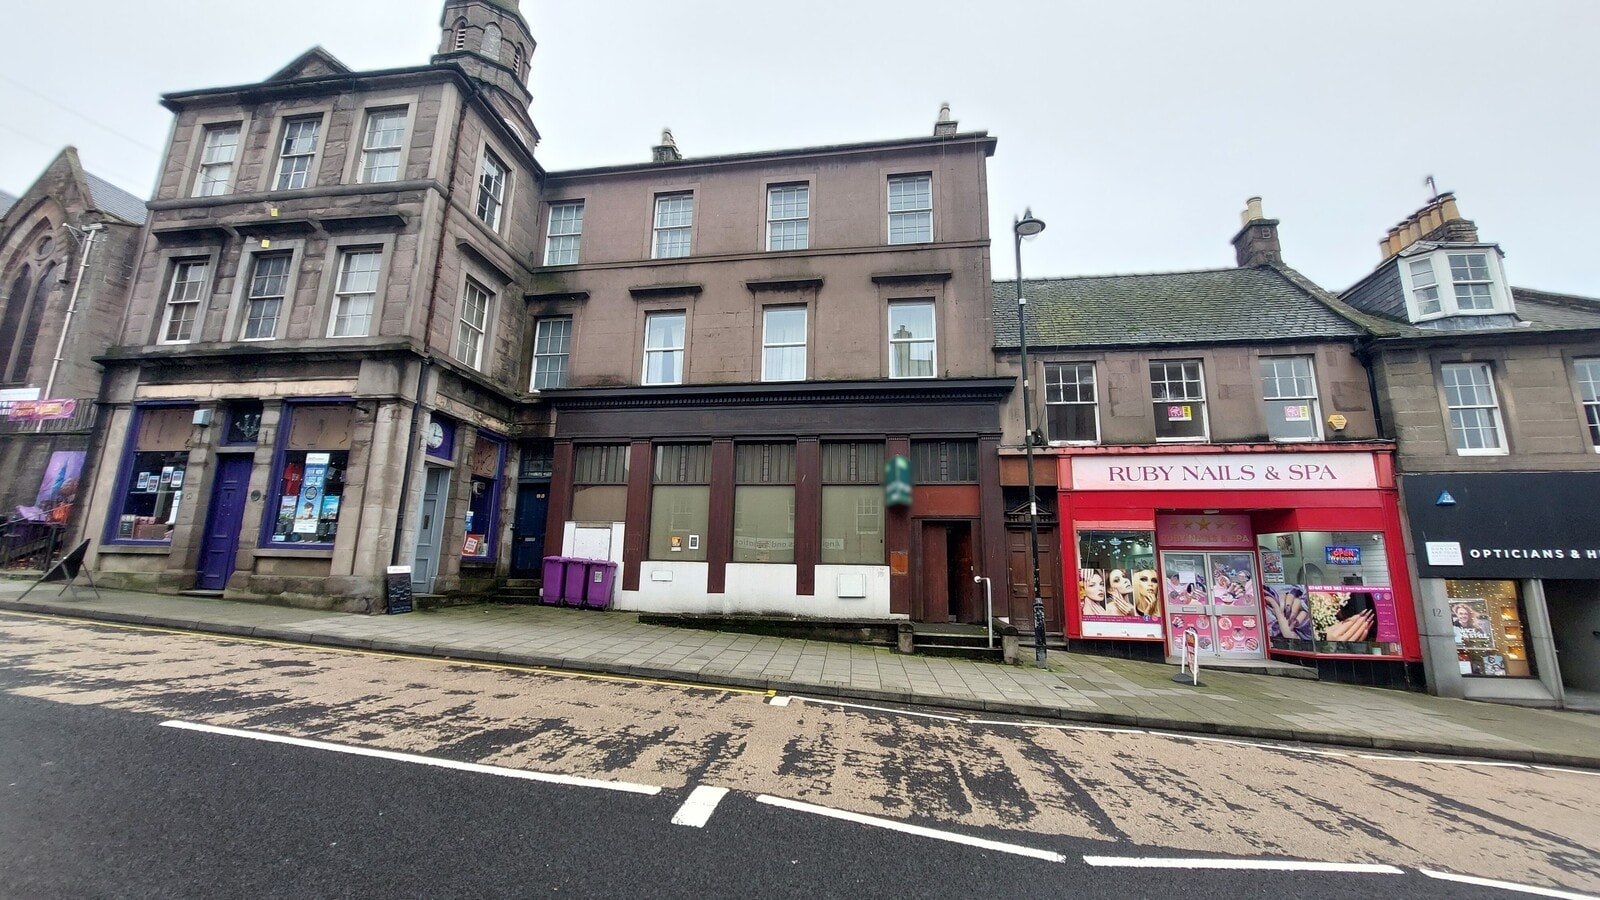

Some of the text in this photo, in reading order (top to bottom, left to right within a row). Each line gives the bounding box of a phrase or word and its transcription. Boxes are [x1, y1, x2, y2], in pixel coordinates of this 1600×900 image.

[1108, 463, 1338, 482] RUBY NAILS & SPA
[1470, 549, 1600, 559] OPTICIANS & H
[1432, 608, 1443, 617] 12
